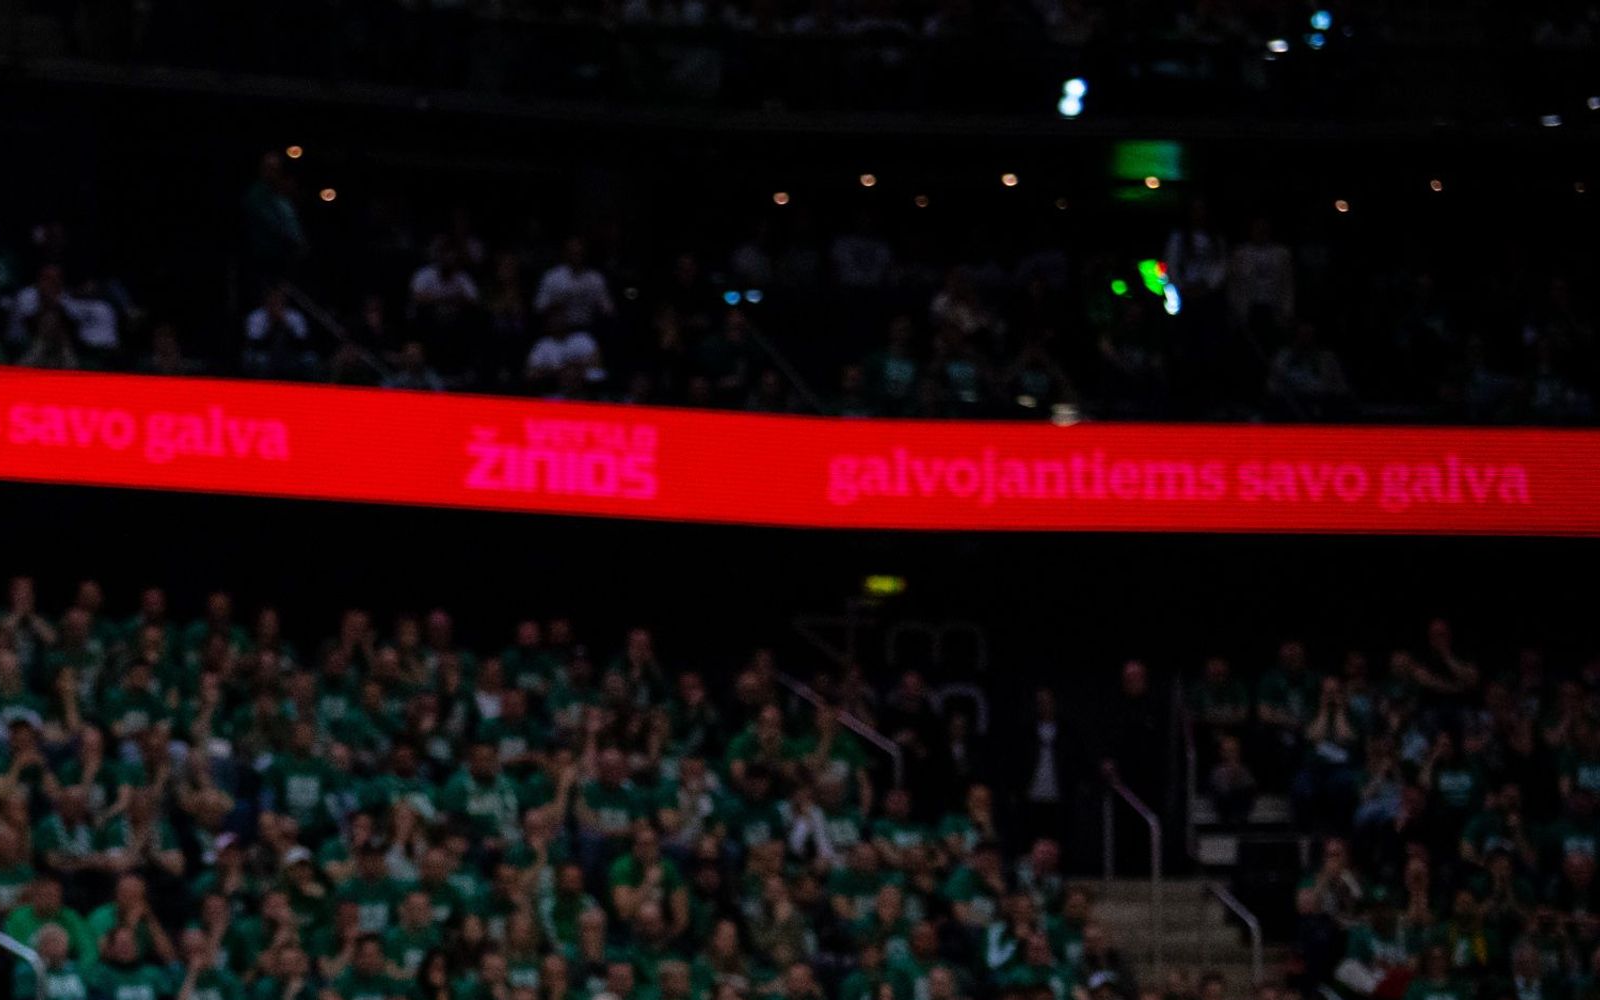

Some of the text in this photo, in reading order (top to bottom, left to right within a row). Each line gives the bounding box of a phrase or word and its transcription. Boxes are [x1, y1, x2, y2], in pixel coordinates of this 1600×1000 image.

[9, 402, 135, 449] savo
[145, 405, 289, 463] galva
[828, 447, 1531, 512] galvojantiems savo galva
